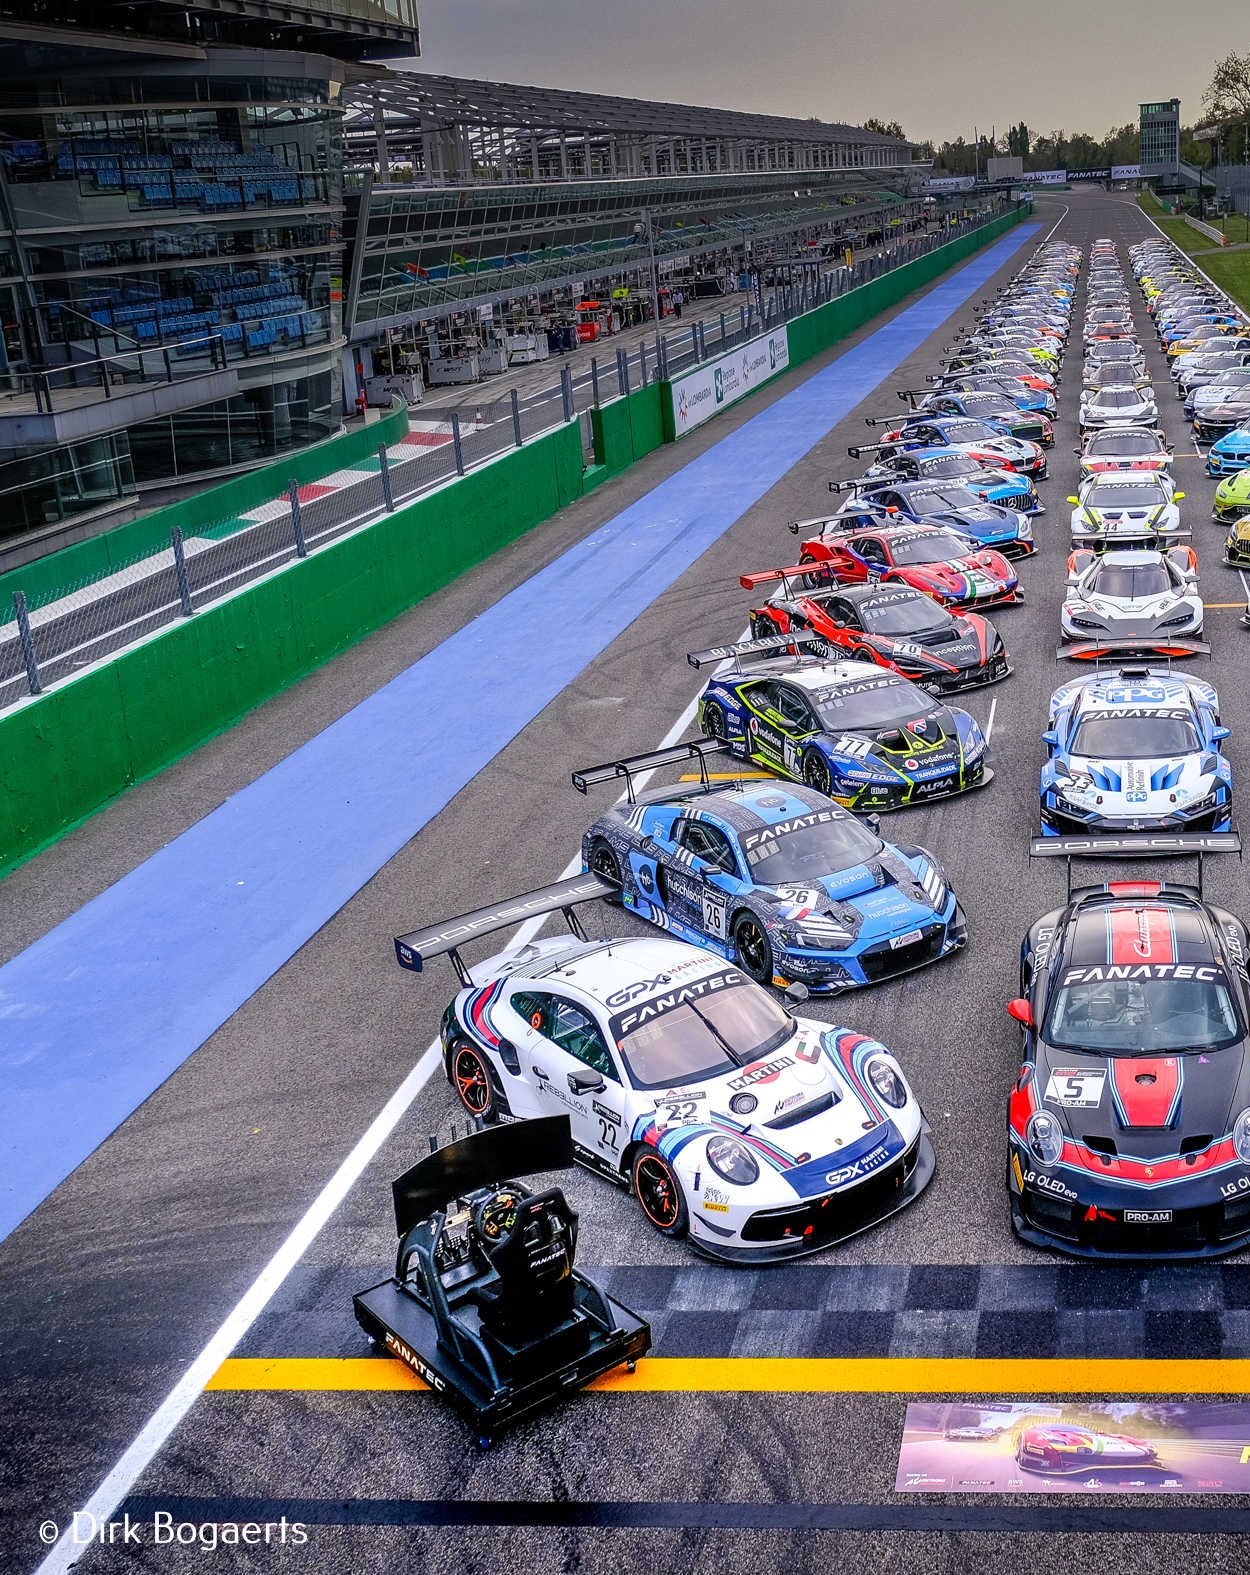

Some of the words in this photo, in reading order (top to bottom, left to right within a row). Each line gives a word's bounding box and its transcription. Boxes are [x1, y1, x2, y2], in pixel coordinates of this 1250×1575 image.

[1067, 170, 1110, 180] FANATEC
[944, 421, 984, 433] FANATEC
[925, 454, 968, 468] FANATEC
[909, 483, 965, 497] FANATEC
[1103, 523, 1119, 532] 44
[891, 530, 950, 546] FANATEC
[860, 592, 924, 609] FANATEC
[710, 641, 758, 657] BLACK
[899, 643, 918, 655] 70
[818, 678, 900, 703] FANATEC
[1081, 709, 1186, 722] FANATEC
[846, 740, 865, 754] 77
[918, 753, 954, 766] vodafone
[872, 773, 900, 782] EDGE
[745, 810, 845, 850] FANATEC
[1035, 838, 1235, 852] PORSCHE
[784, 889, 808, 904] 26
[411, 880, 606, 952] PORSCHE
[705, 902, 721, 930] 26
[400, 945, 413, 958] aws
[1225, 935, 1245, 967] OLED
[667, 956, 714, 976] MARTINI
[1063, 964, 1218, 986] FANATEC
[605, 973, 672, 1008] GPX
[620, 972, 743, 1033] FANATEC
[731, 1056, 795, 1090] MARTINI
[1063, 1077, 1085, 1099] 5
[665, 1101, 698, 1122] 22
[599, 1117, 620, 1152] 22
[825, 1161, 864, 1186] GPX
[1023, 1169, 1035, 1183] LG
[1036, 1174, 1066, 1193] OLED
[1064, 1187, 1078, 1200] evo
[1220, 1182, 1238, 1198] LG
[1126, 1211, 1170, 1222] PRO-AM
[529, 1248, 567, 1269] FANATEC
[384, 1331, 446, 1391] FANATEC
